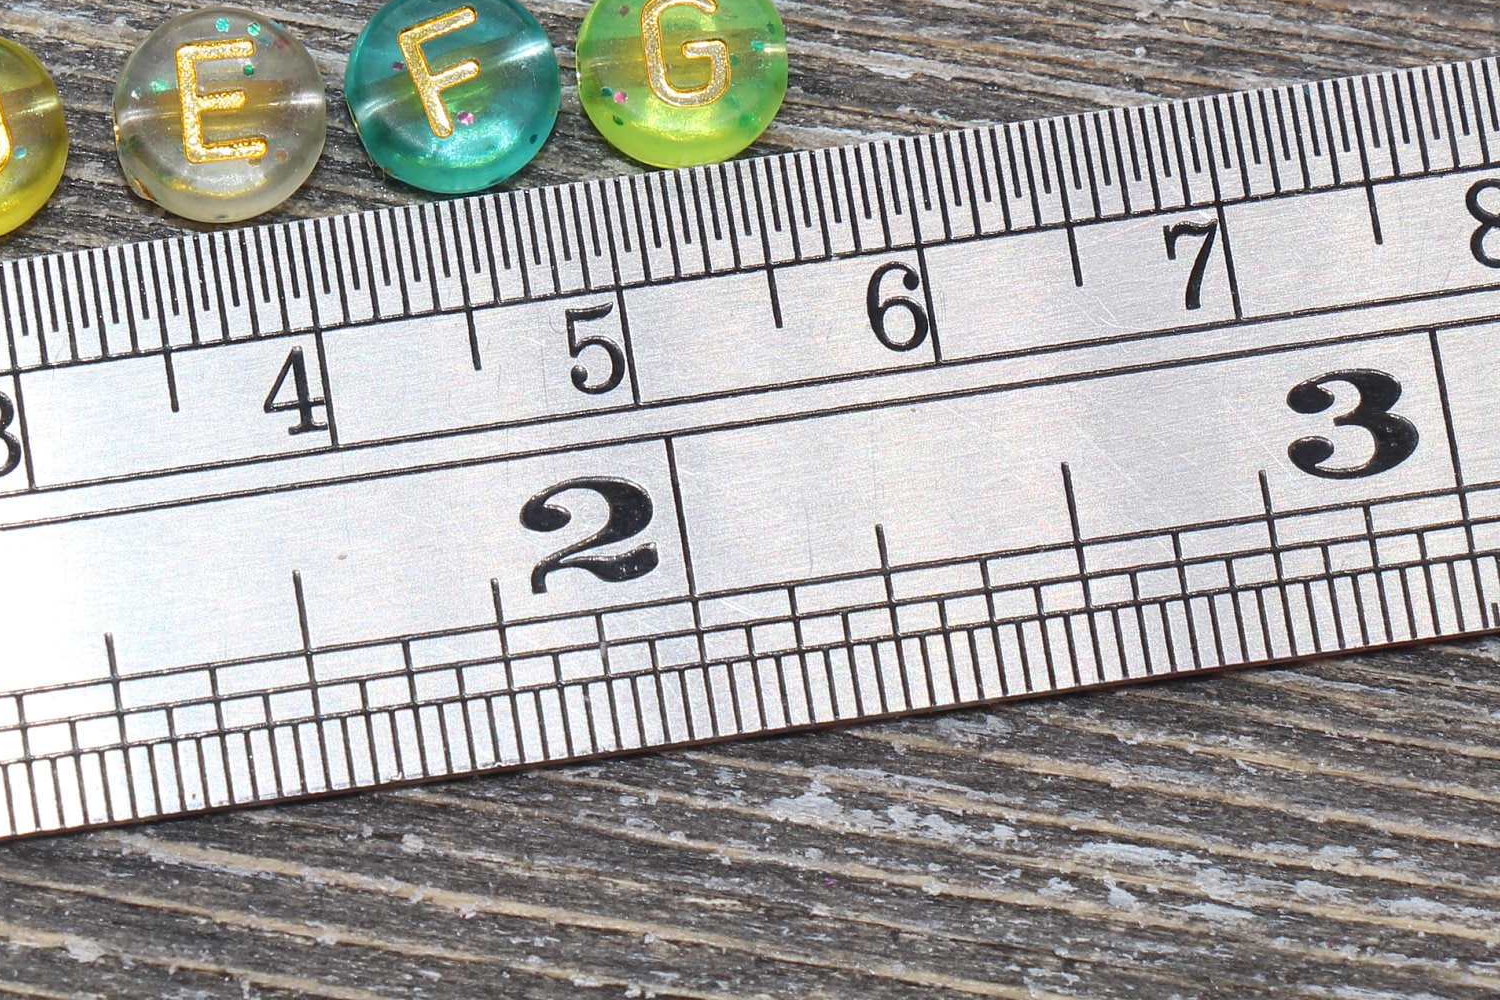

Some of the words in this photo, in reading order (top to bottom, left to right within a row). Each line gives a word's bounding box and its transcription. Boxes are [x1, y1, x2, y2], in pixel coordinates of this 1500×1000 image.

[175, 38, 268, 164] E
[397, 5, 481, 139] F
[263, 346, 327, 435] 4
[565, 301, 625, 395] 5
[867, 261, 929, 353] 6
[1163, 219, 1217, 310] 7
[519, 475, 659, 594] 2
[1285, 367, 1419, 479] 3
